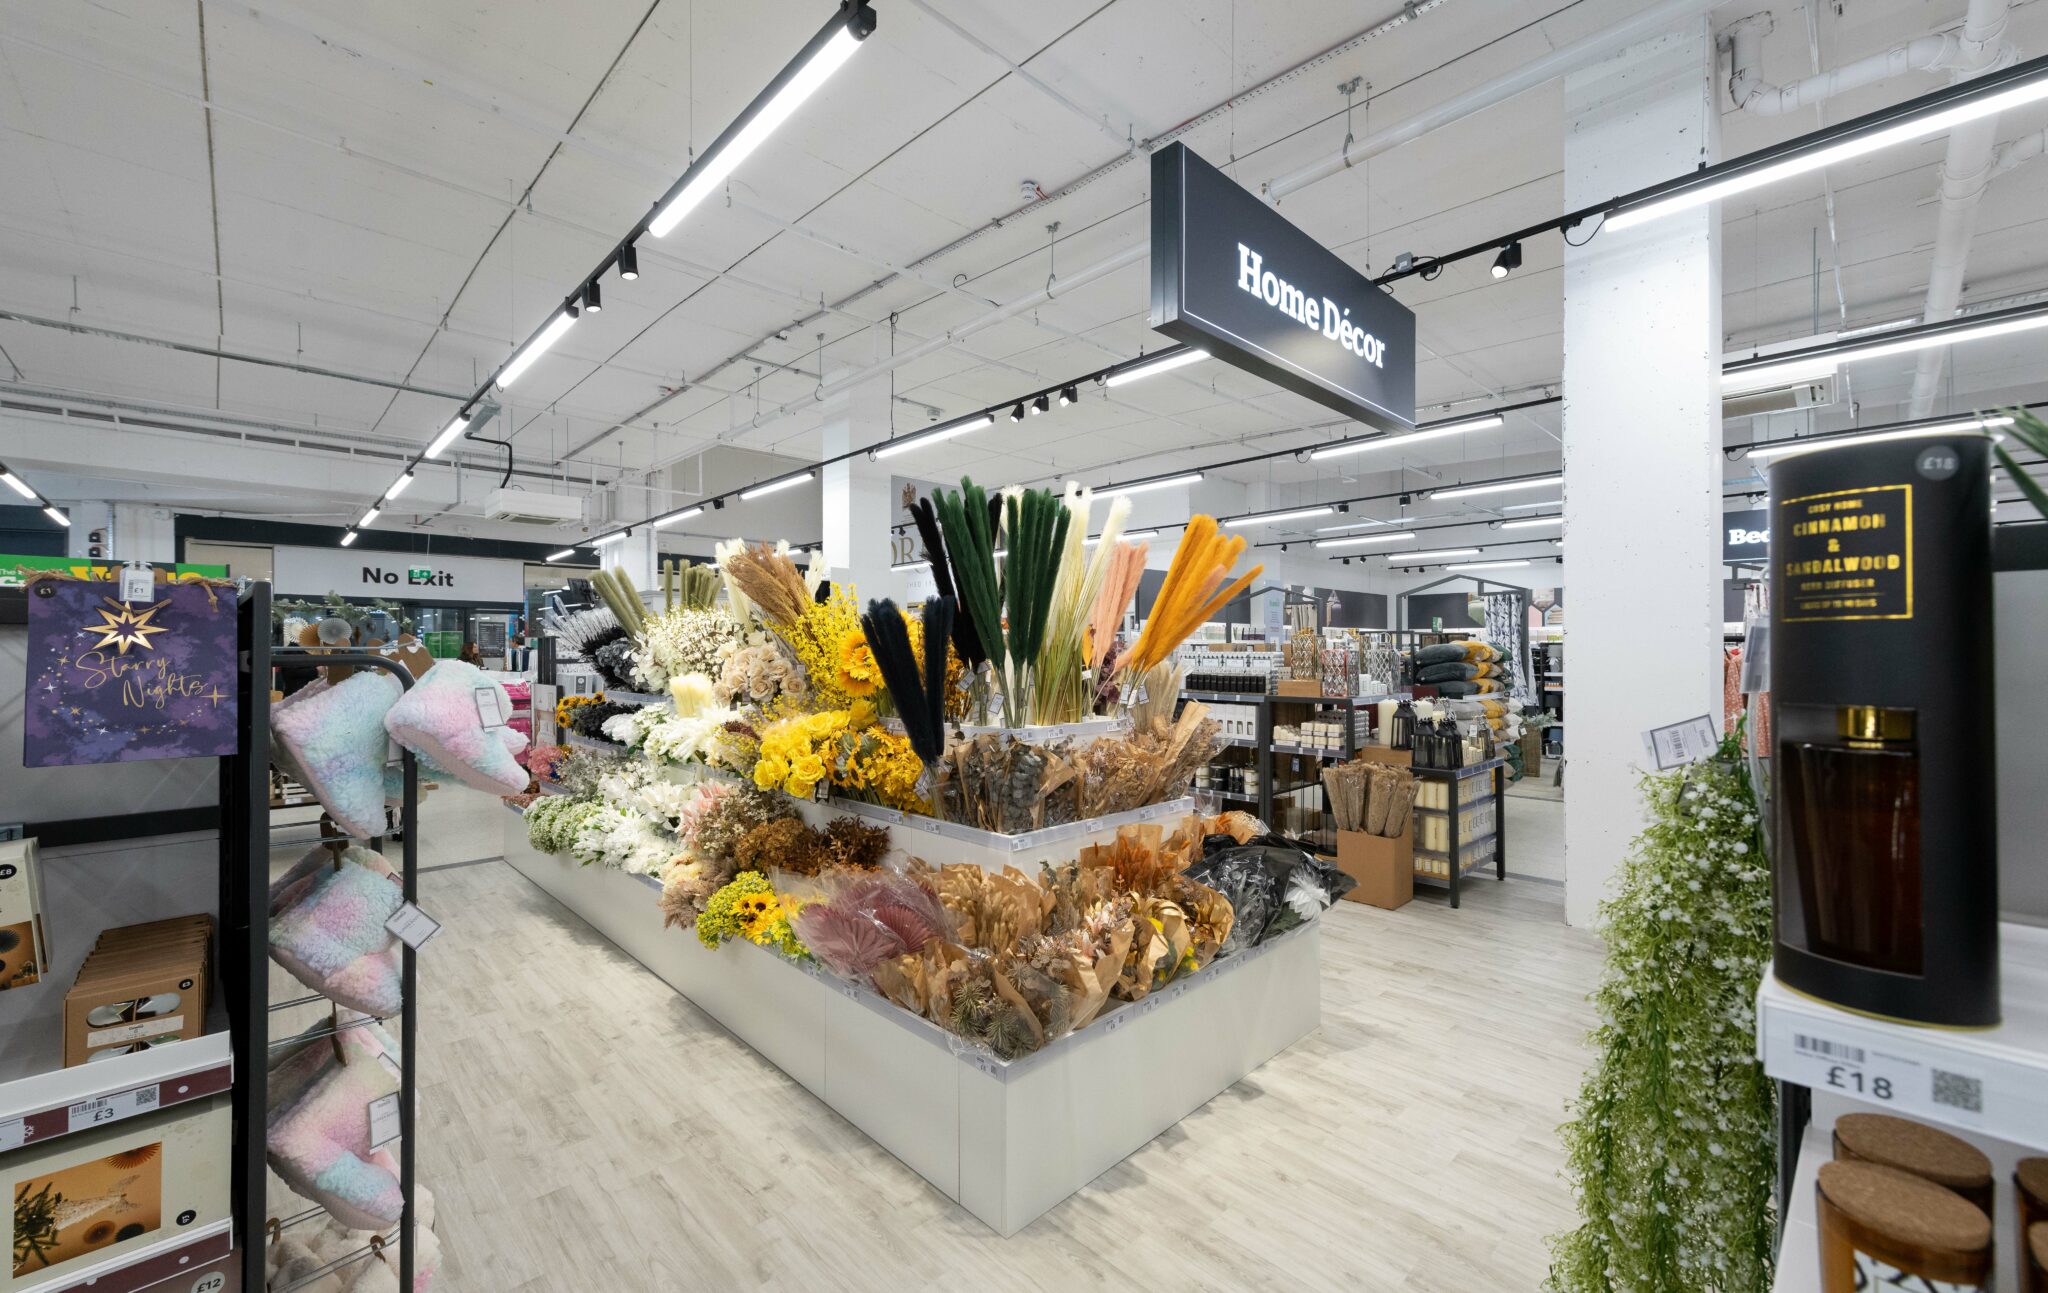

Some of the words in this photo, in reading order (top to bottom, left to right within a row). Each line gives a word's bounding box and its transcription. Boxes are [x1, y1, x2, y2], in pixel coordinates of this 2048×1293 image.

[1238, 242, 1319, 331] Home
[1322, 297, 1386, 369] Décor
[1923, 456, 1955, 470] £18
[1793, 513, 1886, 537] CINNAMON
[1827, 538, 1840, 553] &
[362, 567, 399, 584] No
[1786, 554, 1900, 576] SANDALWOOD
[75, 651, 170, 689] Starry
[123, 672, 209, 709] Nights
[1826, 1066, 1894, 1100] £18
[93, 1107, 114, 1122] £3
[197, 1277, 221, 1293] £12
